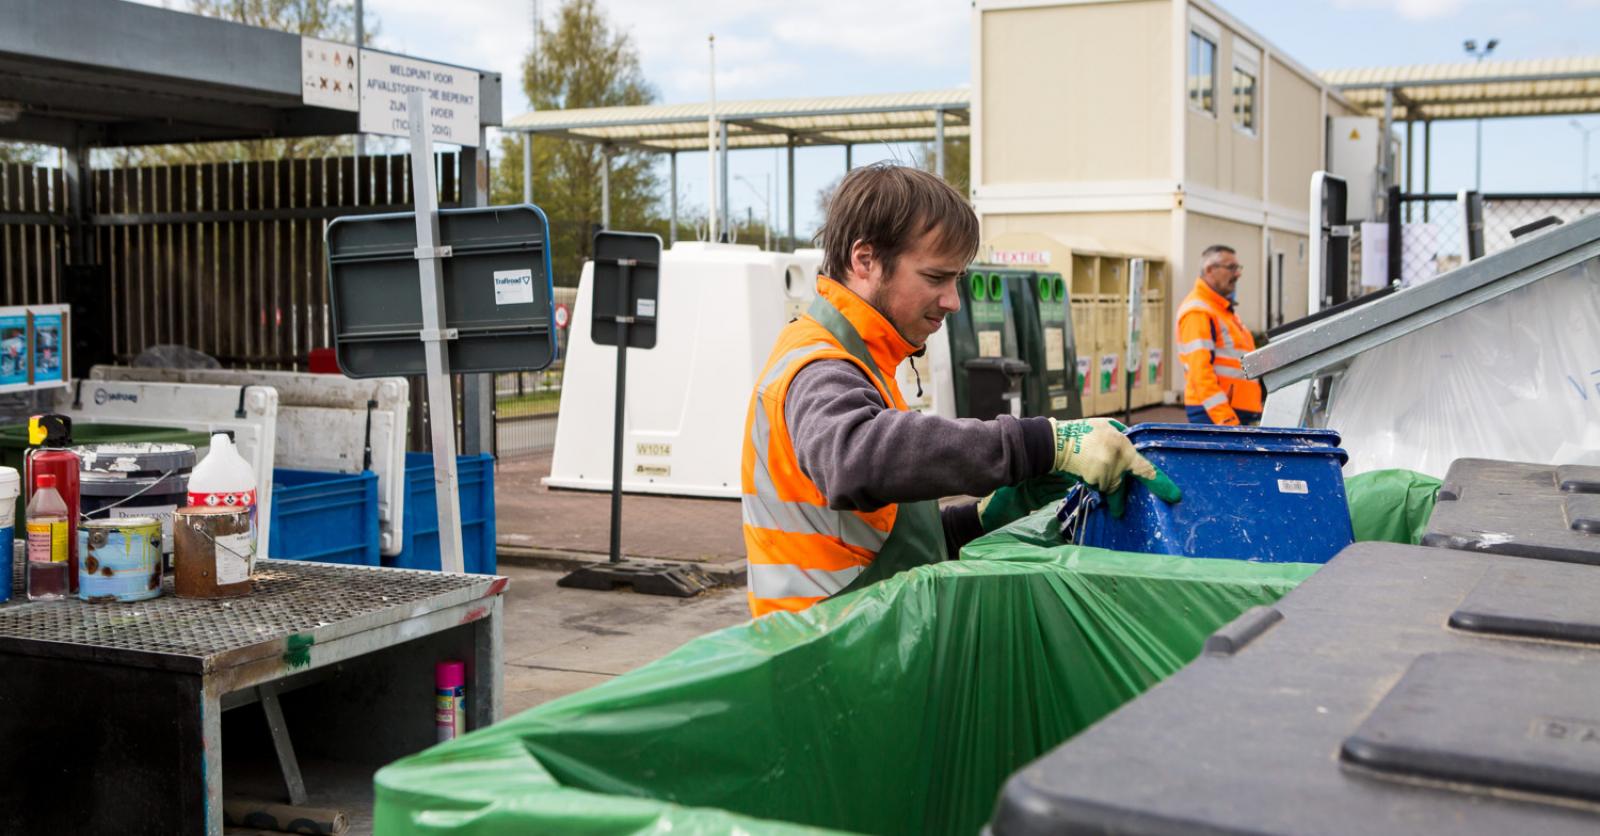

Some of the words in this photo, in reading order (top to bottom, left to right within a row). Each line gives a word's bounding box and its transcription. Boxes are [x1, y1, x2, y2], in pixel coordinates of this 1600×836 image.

[389, 65, 431, 80] MELDPUNT
[432, 72, 454, 84] VOOR
[441, 91, 474, 105] BEPERKT
[389, 100, 406, 112] ZIJN
[996, 251, 1047, 263] TEXTIEL
